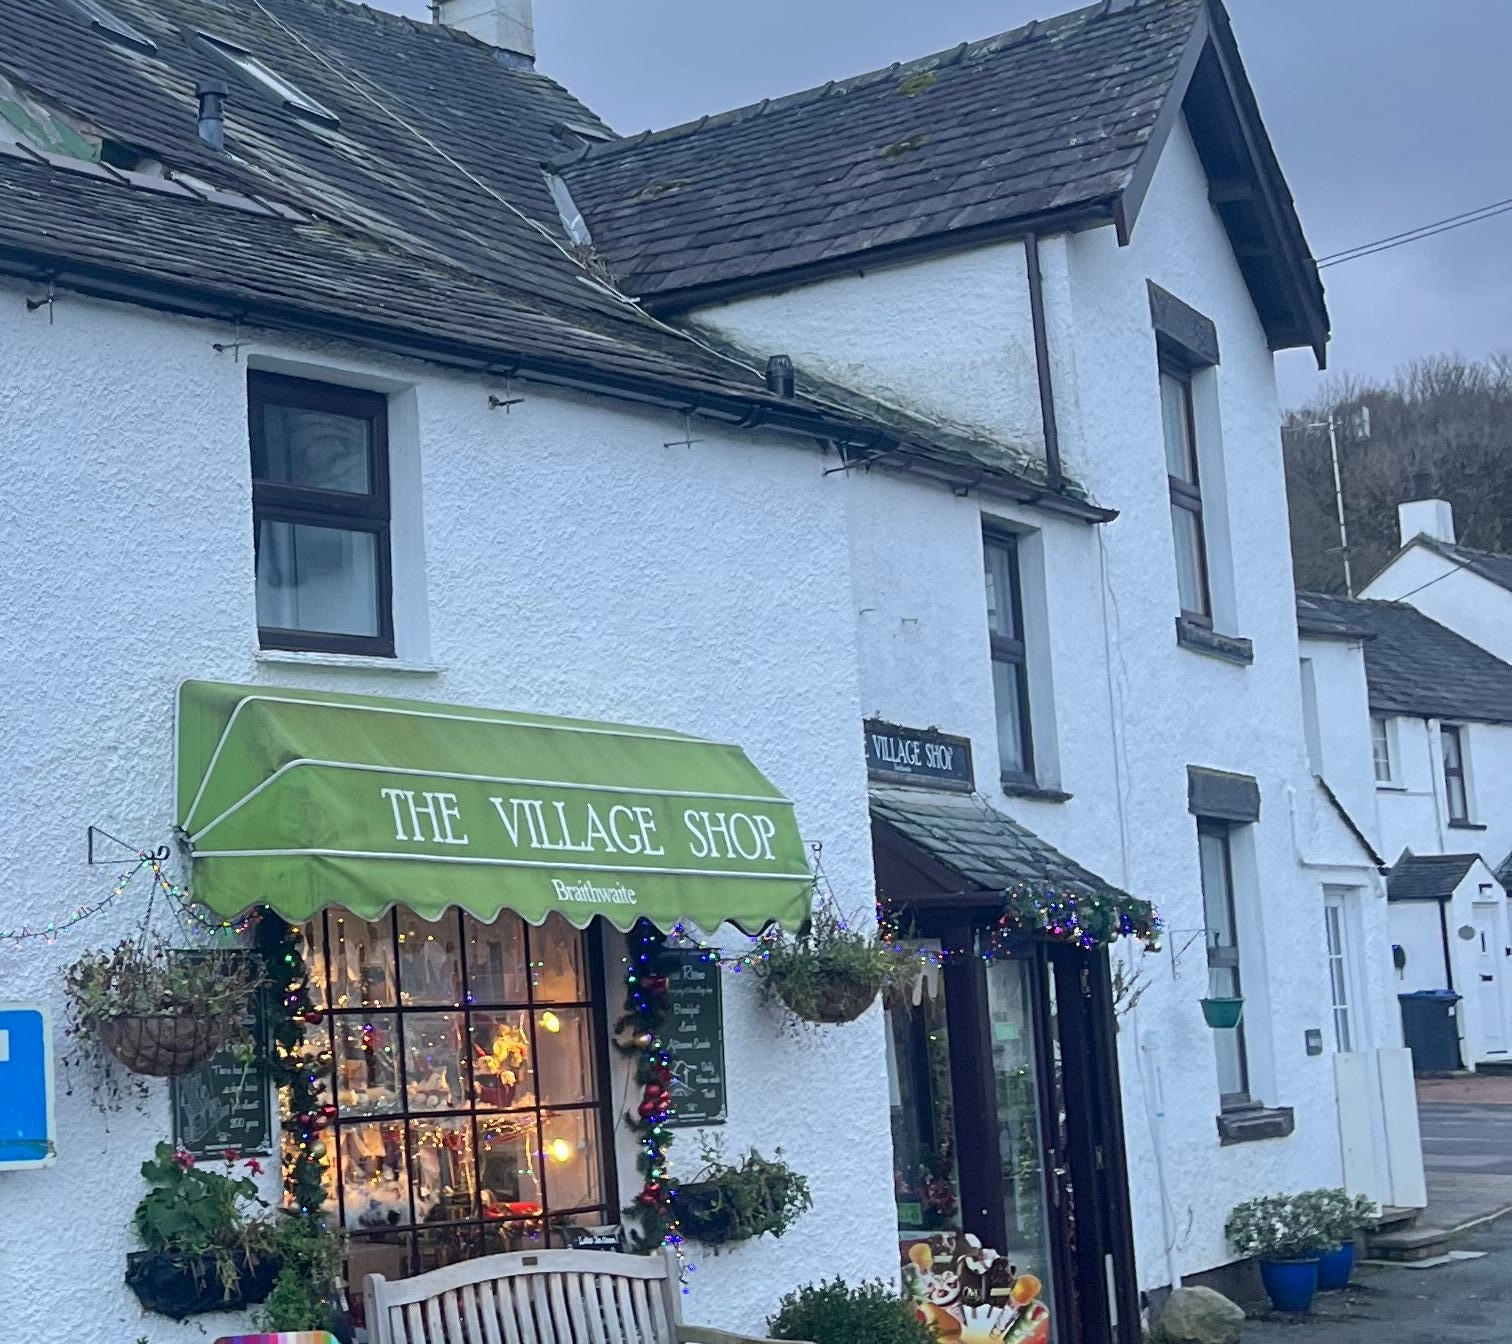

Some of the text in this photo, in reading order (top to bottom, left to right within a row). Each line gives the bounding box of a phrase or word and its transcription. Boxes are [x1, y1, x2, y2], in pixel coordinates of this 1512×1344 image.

[871, 735, 922, 766] VILLAGE
[381, 788, 777, 861] THE VILLAGE SHOP
[551, 879, 638, 905] Braithwaite
